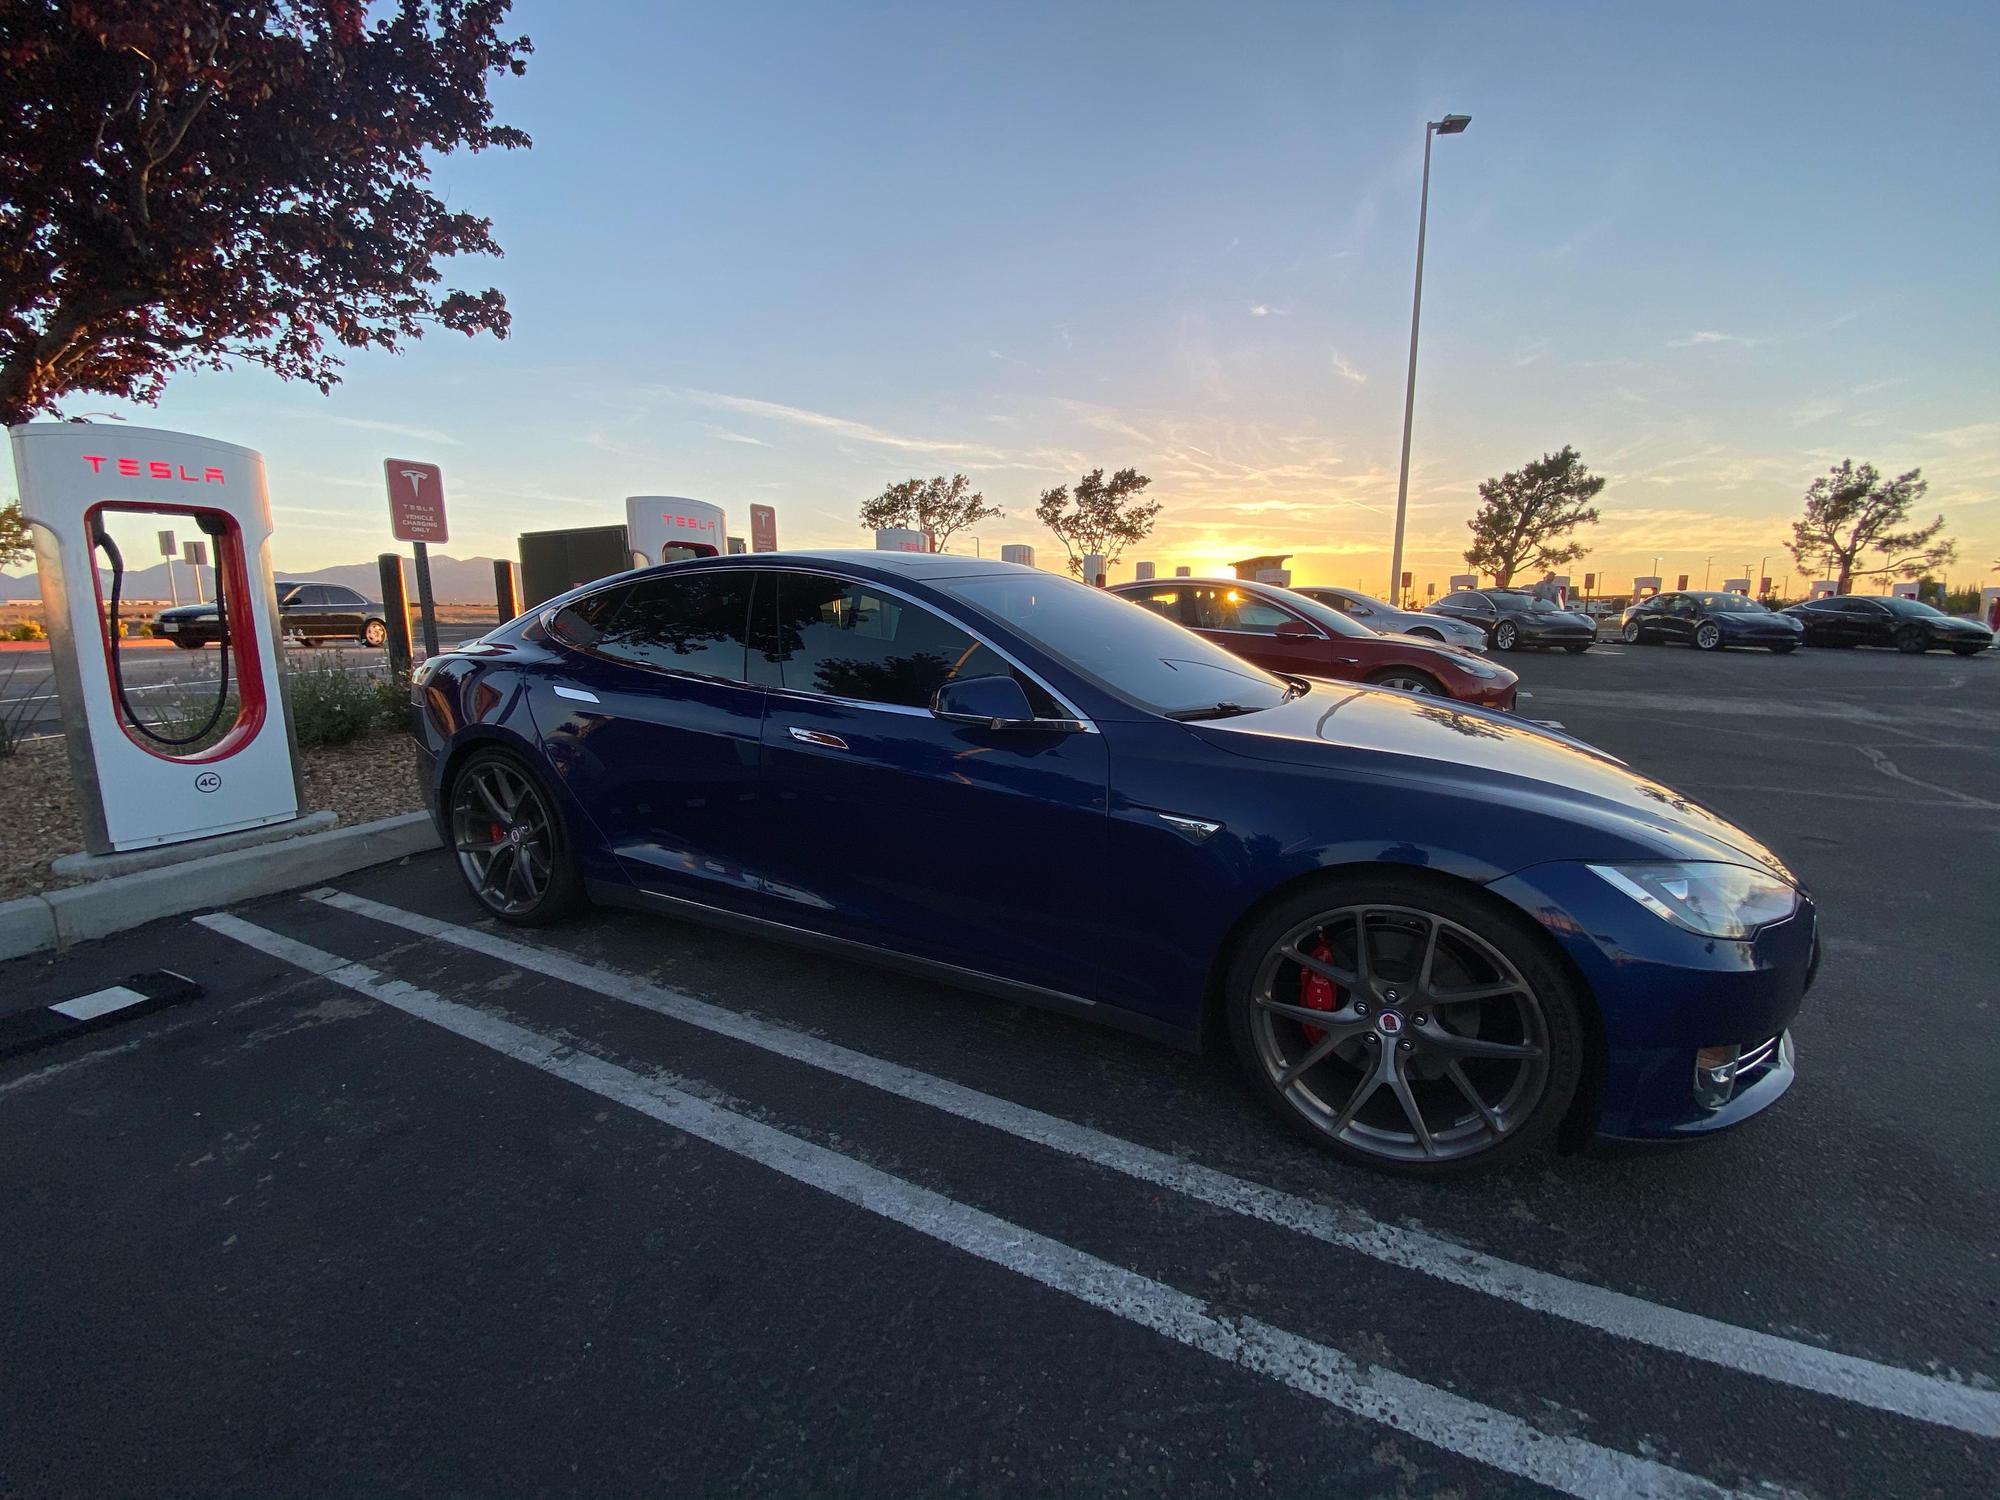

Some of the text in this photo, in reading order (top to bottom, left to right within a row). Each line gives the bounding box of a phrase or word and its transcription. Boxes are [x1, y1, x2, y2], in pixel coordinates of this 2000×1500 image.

[82, 455, 225, 485] TESLA
[402, 503, 435, 512] TESLA
[405, 513, 434, 521] VEHICLE
[402, 519, 438, 528] CHARGING
[662, 513, 715, 531] TESLA
[200, 777, 217, 786] 4C
